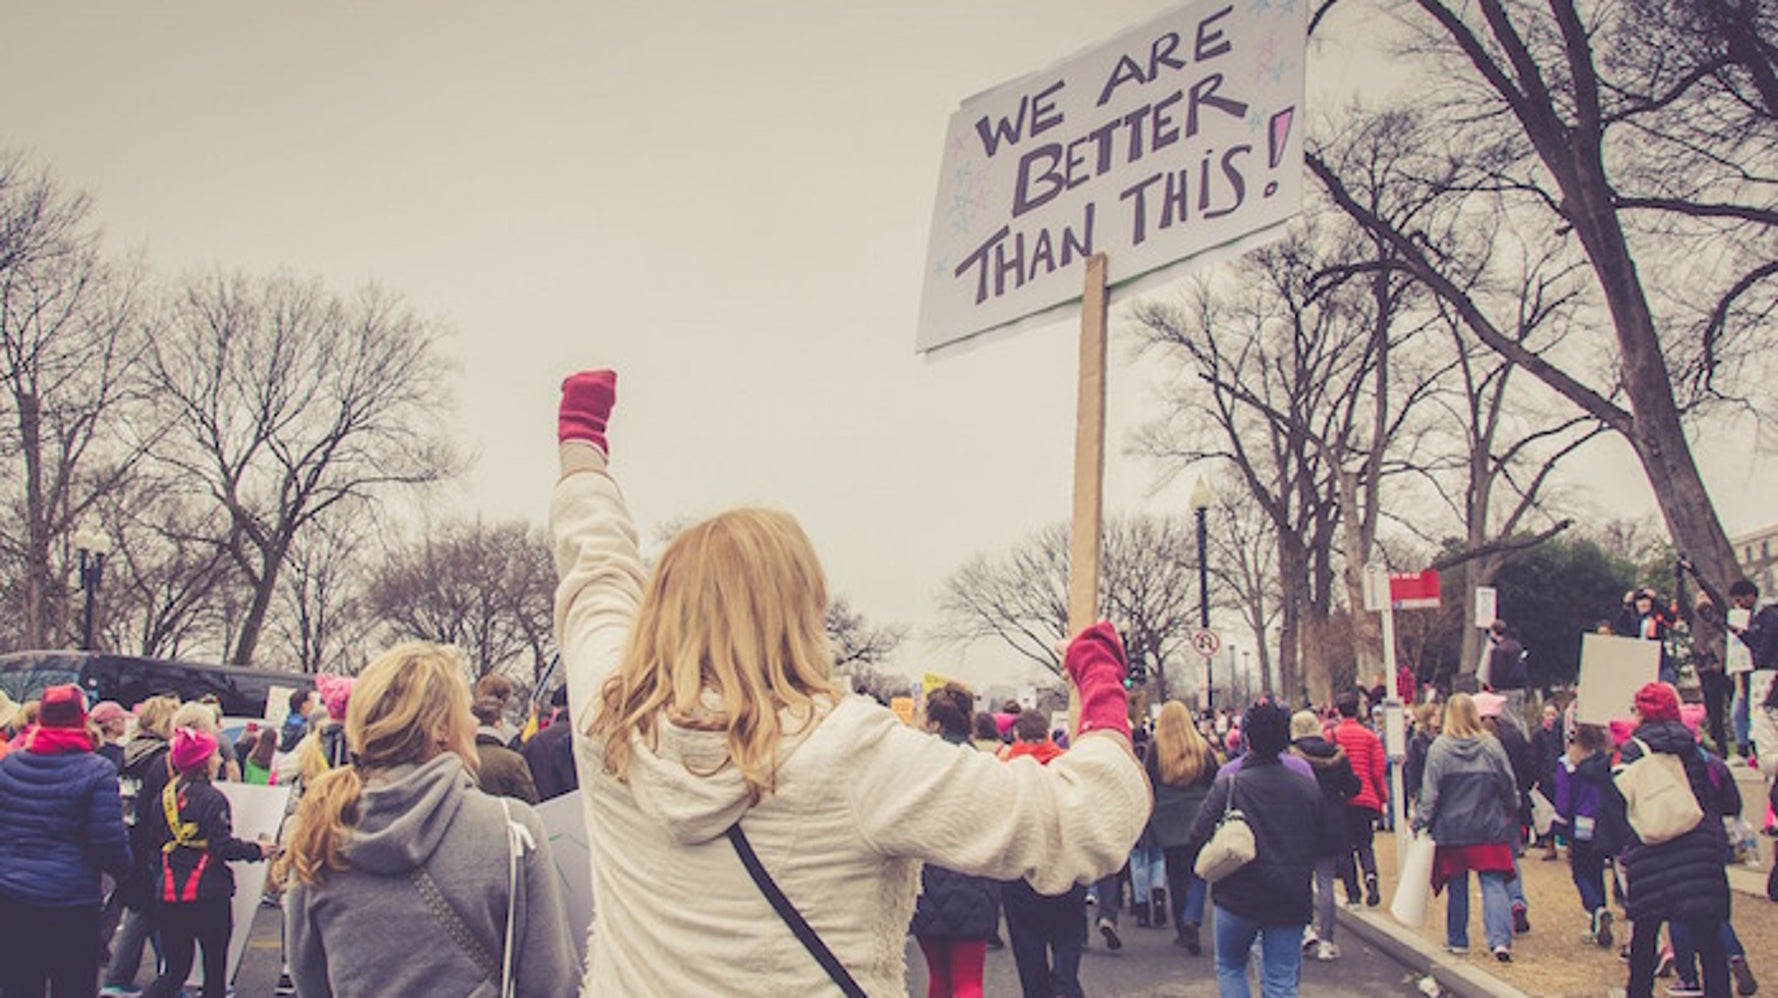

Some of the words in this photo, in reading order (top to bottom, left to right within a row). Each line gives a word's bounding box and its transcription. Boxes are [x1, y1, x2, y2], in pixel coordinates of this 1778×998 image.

[974, 80, 1065, 158] WE
[1096, 5, 1234, 107] ARE
[1011, 73, 1249, 218] BETTER
[954, 202, 1095, 306] THAN
